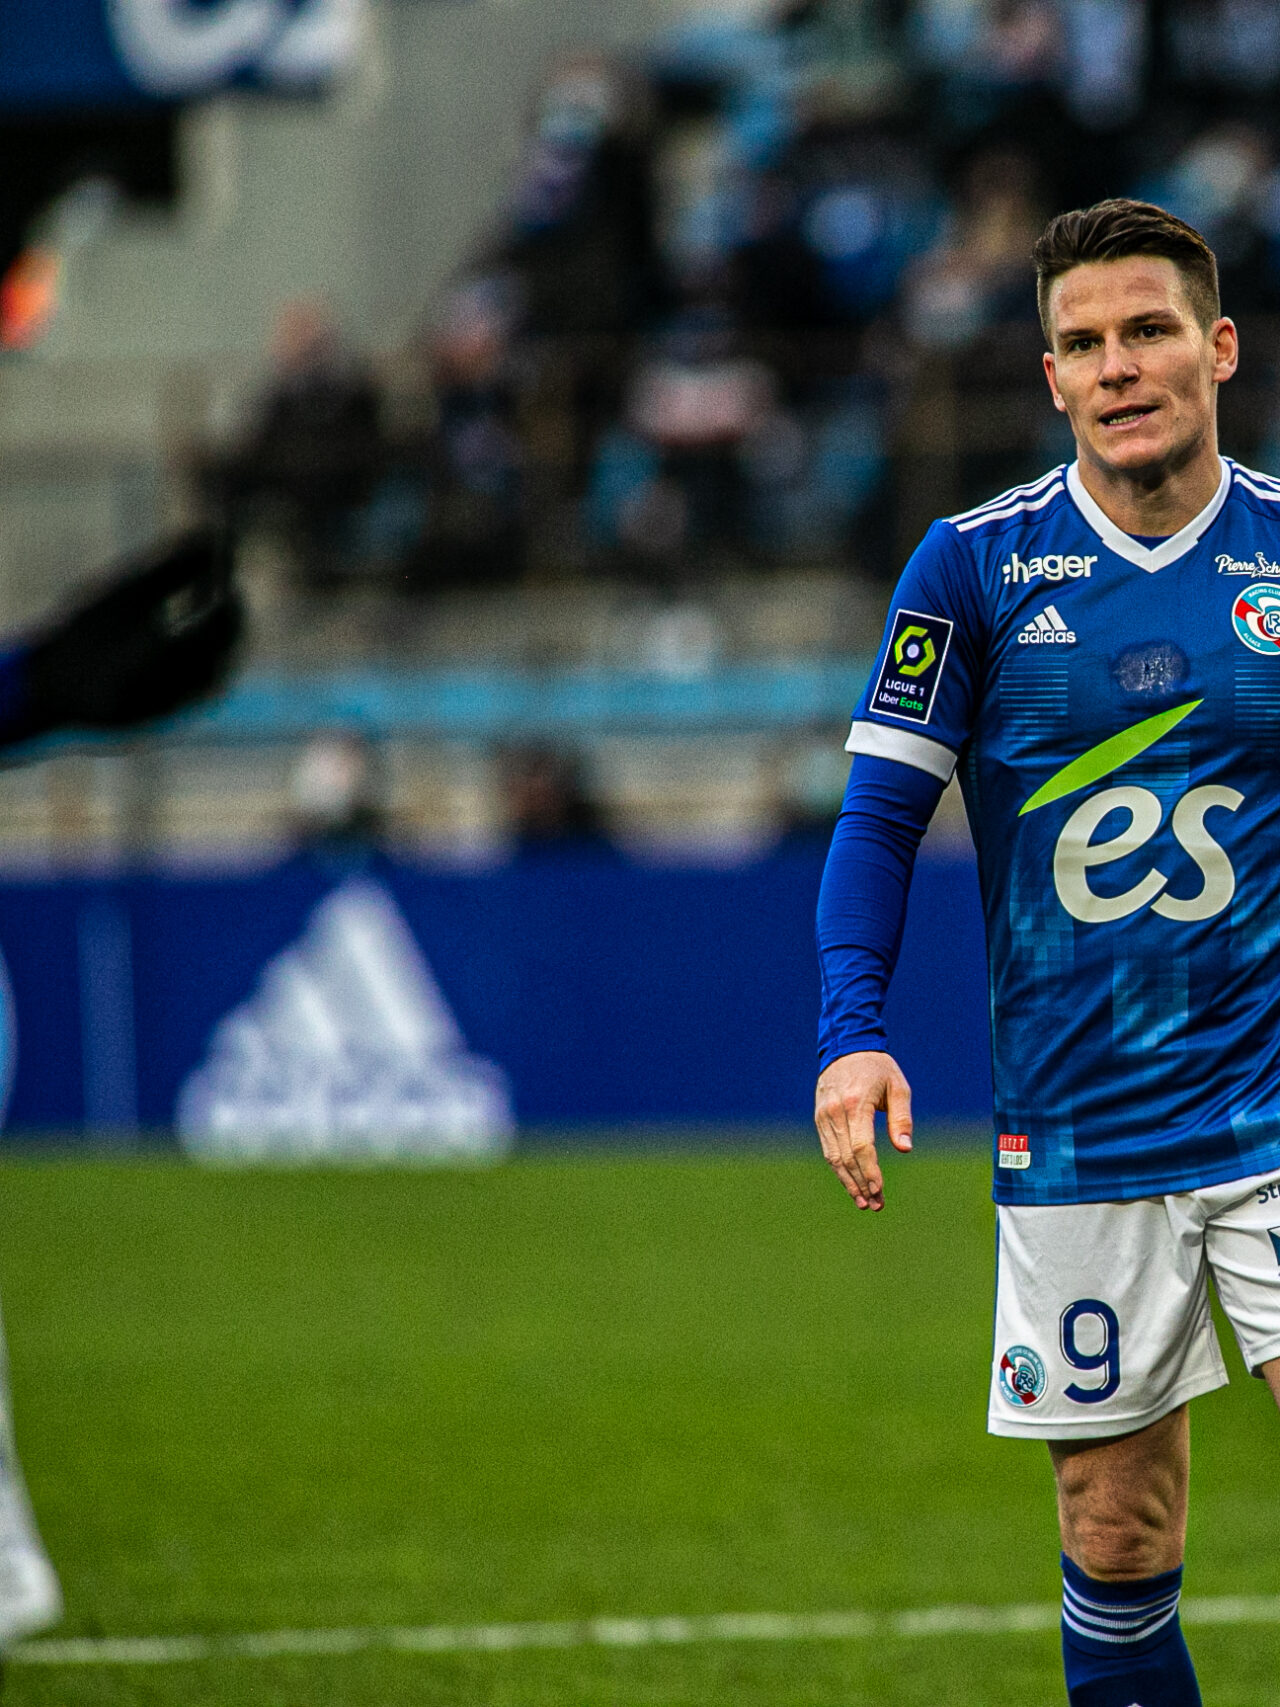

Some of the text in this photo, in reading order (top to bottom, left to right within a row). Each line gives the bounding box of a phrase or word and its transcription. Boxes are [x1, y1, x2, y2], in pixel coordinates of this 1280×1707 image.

[1215, 554, 1256, 573] Pierre
[1017, 628, 1077, 644] adidas
[885, 678, 925, 697] LIGUE 1
[878, 691, 924, 711] Uber Eats
[1059, 1298, 1121, 1404] 9
